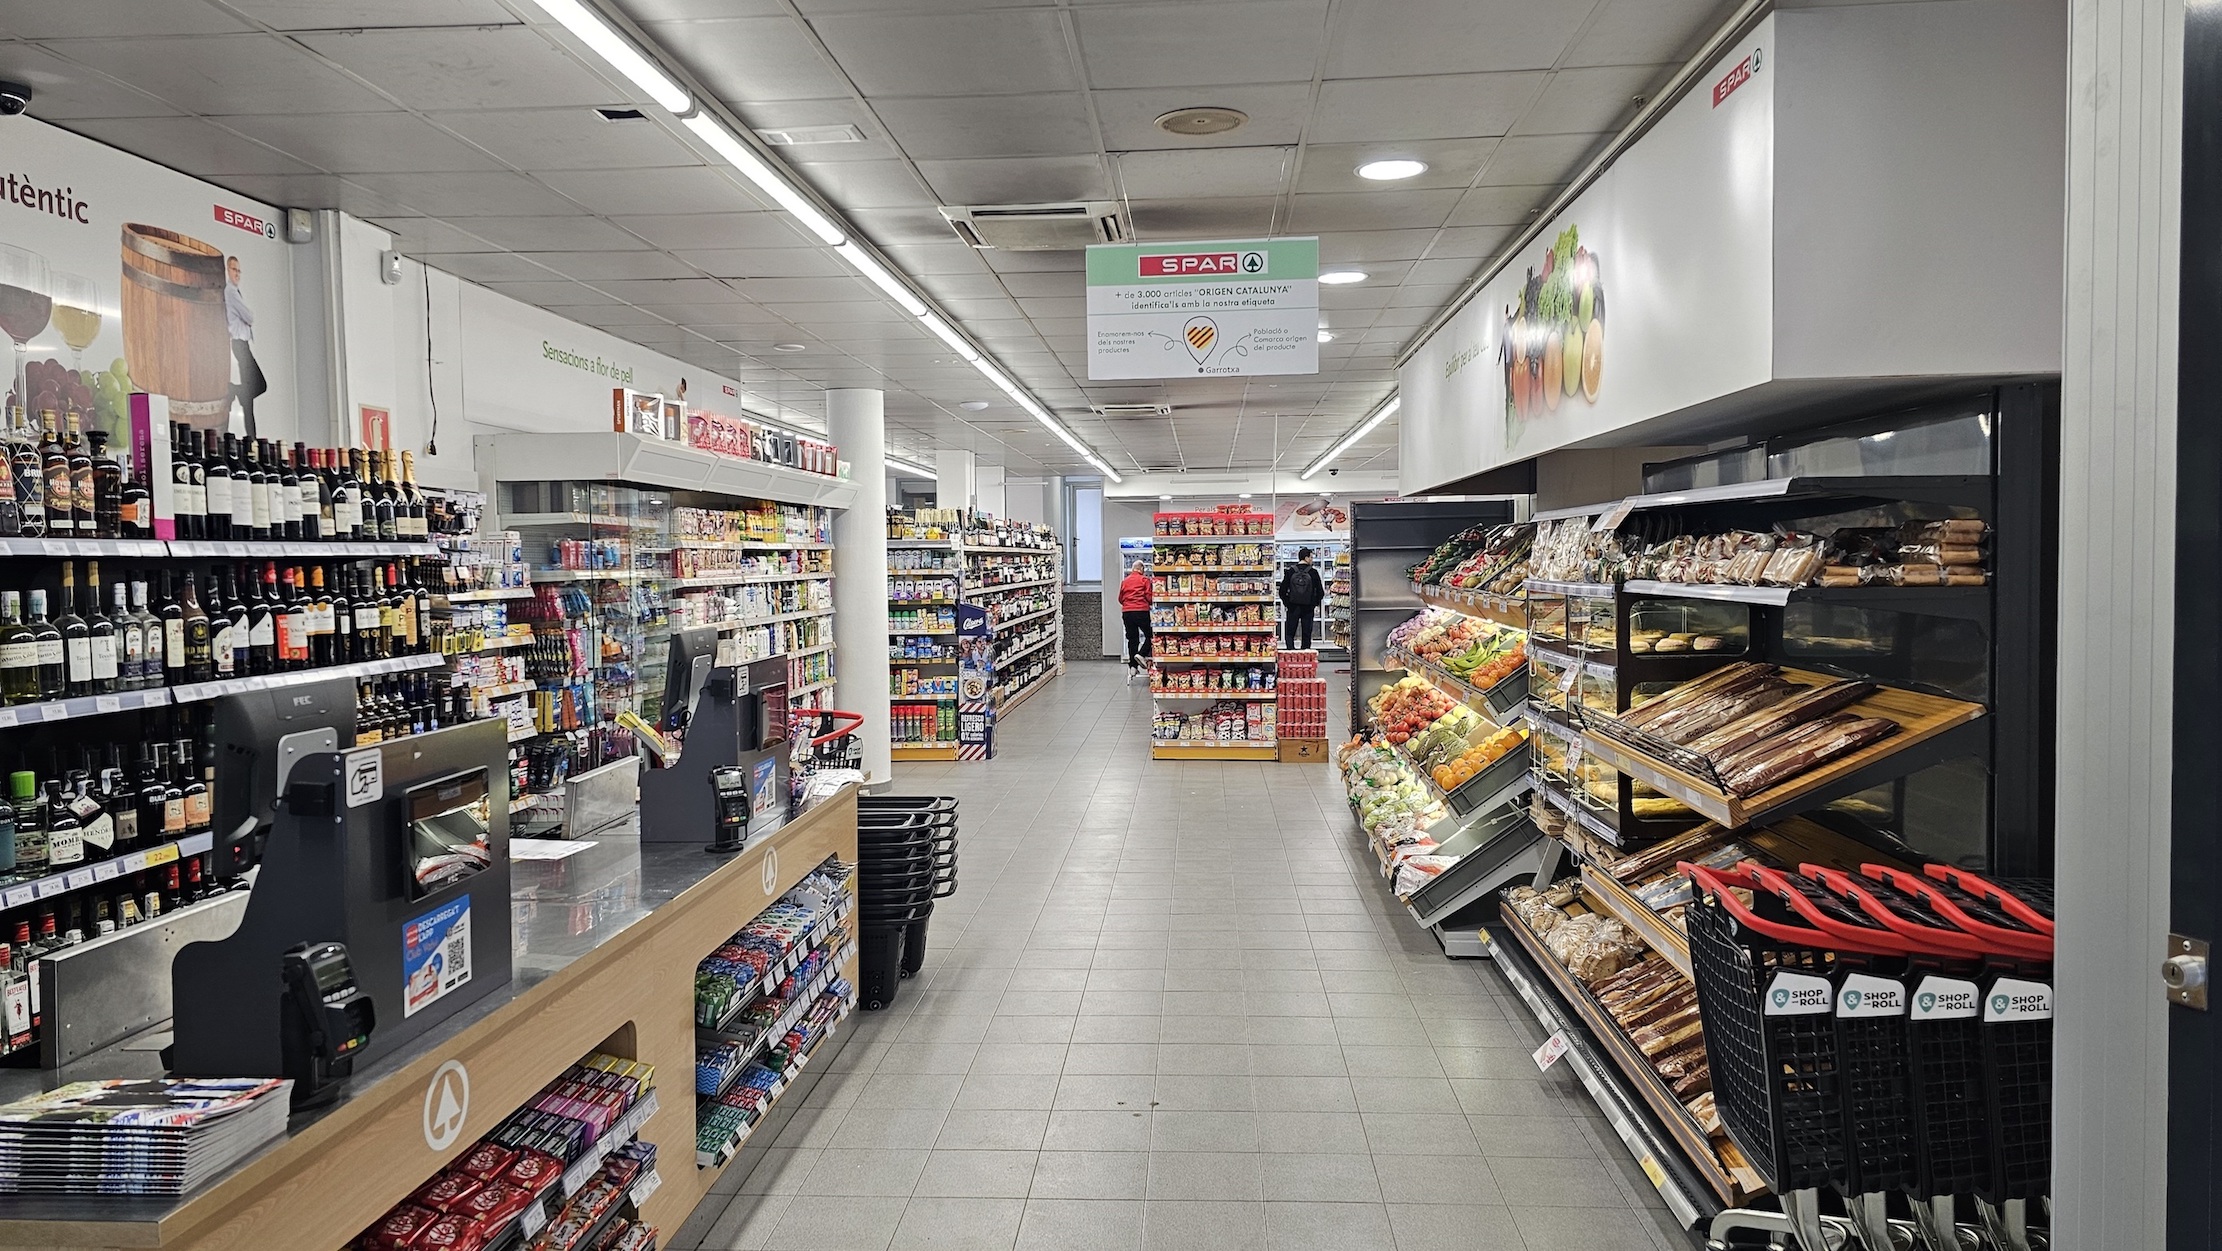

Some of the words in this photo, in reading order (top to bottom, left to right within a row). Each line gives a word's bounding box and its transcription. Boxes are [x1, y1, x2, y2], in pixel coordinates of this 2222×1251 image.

[1720, 59, 1750, 99] SPAR
[223, 210, 263, 233] SPAR
[1162, 256, 1236, 273] SPAR
[1124, 291, 1135, 299] de
[1137, 290, 1161, 298] 3.000
[1163, 290, 1192, 298] articles
[1131, 301, 1179, 310] identifica'ls
[1181, 300, 1199, 308] amb
[1202, 299, 1210, 307] la
[1213, 298, 1239, 307] nostra
[1241, 297, 1275, 307] etiqueta
[1285, 335, 1307, 343] origen
[1266, 343, 1296, 352] producte
[542, 340, 588, 371] Sensacions
[590, 360, 595, 372] a
[596, 356, 609, 377] flor
[610, 361, 619, 380] de
[620, 366, 634, 386] pell
[1205, 366, 1240, 374] Garrotxa
[961, 722, 984, 732] LIGERO
[1791, 989, 1824, 999] SHOP
[1863, 991, 1896, 1000] SHOP
[1938, 993, 1970, 1003] SHOP
[1800, 997, 1829, 1006] ROLL
[1872, 1000, 1902, 1009] ROLL
[2011, 995, 2044, 1005] SHOP
[1946, 1001, 1976, 1010] ROLL
[2020, 1003, 2050, 1012] ROLL
